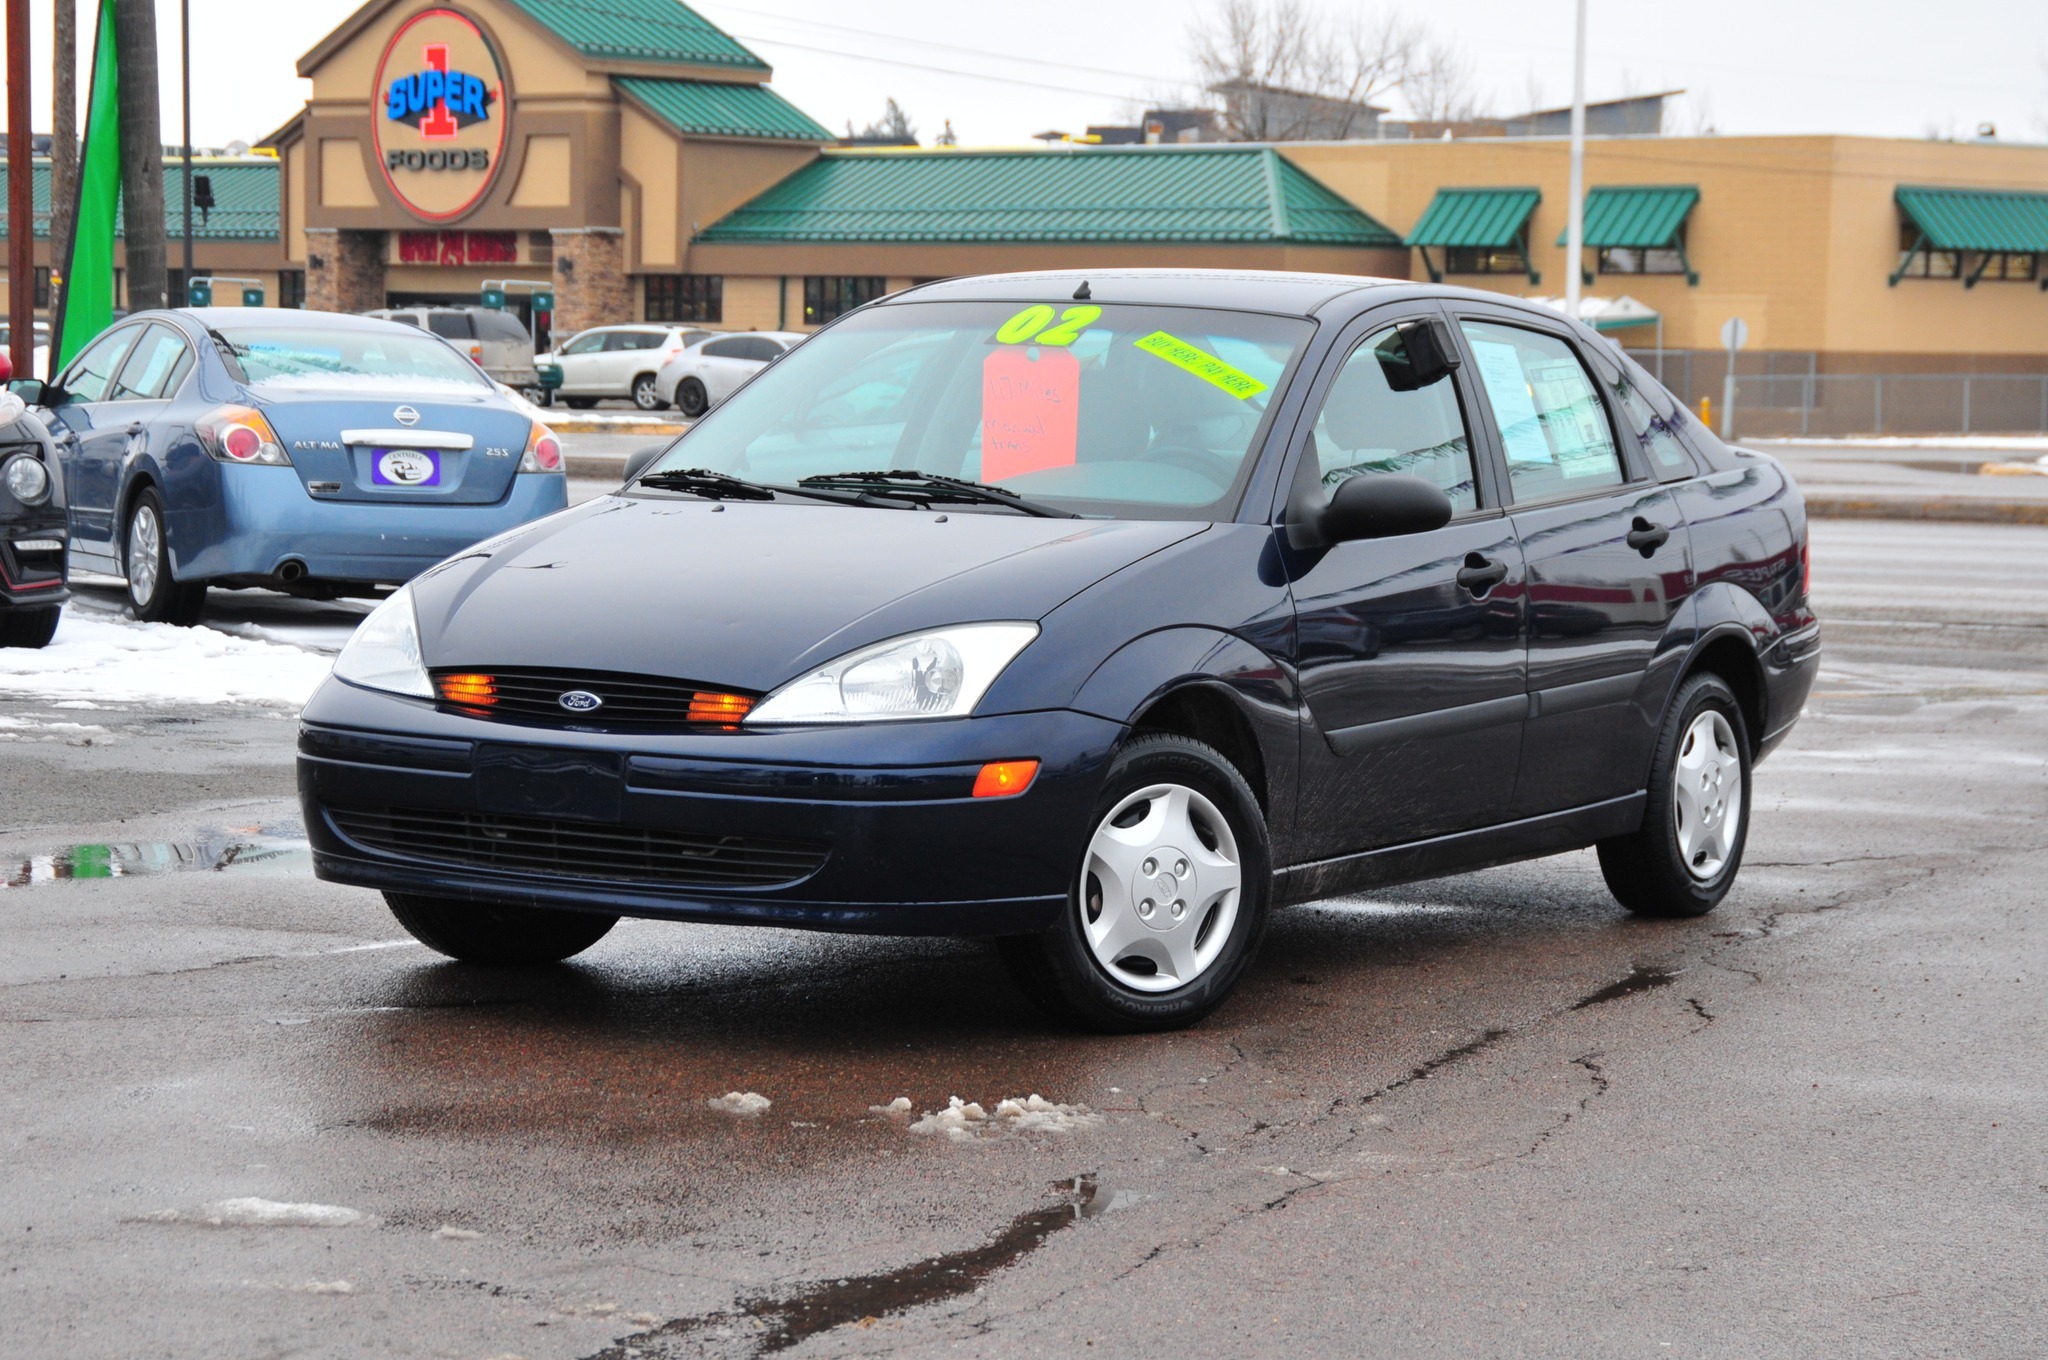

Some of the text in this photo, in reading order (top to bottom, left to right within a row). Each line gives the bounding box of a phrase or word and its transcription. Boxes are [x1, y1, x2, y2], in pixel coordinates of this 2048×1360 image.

[387, 43, 488, 139] SUPER 1
[387, 148, 489, 171] FOODS
[996, 304, 1102, 346] 02
[1146, 336, 1257, 392] BUY HERE PAY HERE
[568, 694, 591, 708] Ford
